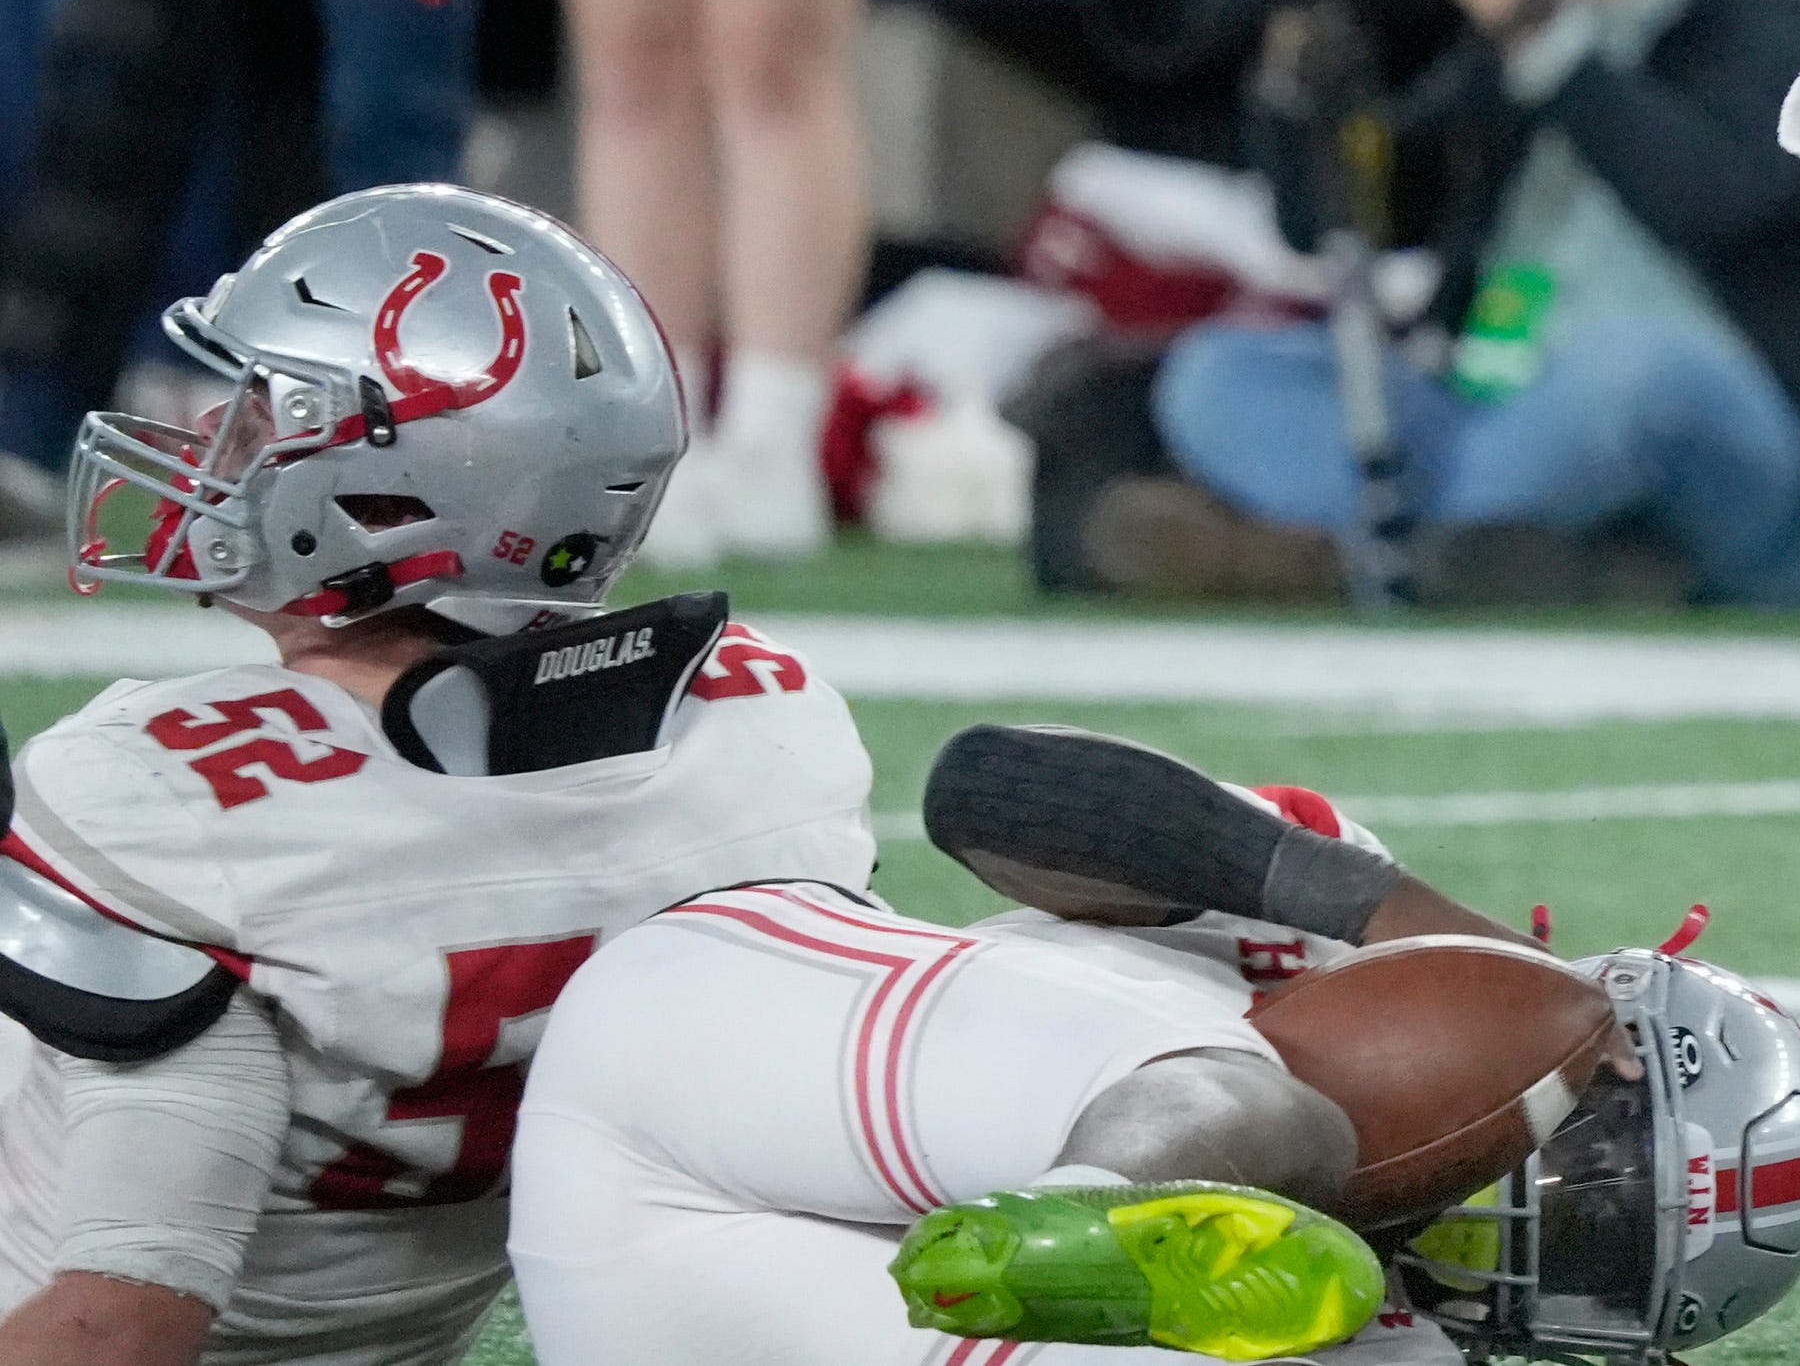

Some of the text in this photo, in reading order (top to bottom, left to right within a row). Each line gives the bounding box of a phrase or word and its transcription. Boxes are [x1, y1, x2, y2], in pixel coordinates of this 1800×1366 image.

[492, 530, 535, 566] 52
[533, 626, 656, 686] DOUGLAS
[688, 622, 807, 702] 5
[144, 688, 370, 809] 52
[308, 929, 605, 1212] 5
